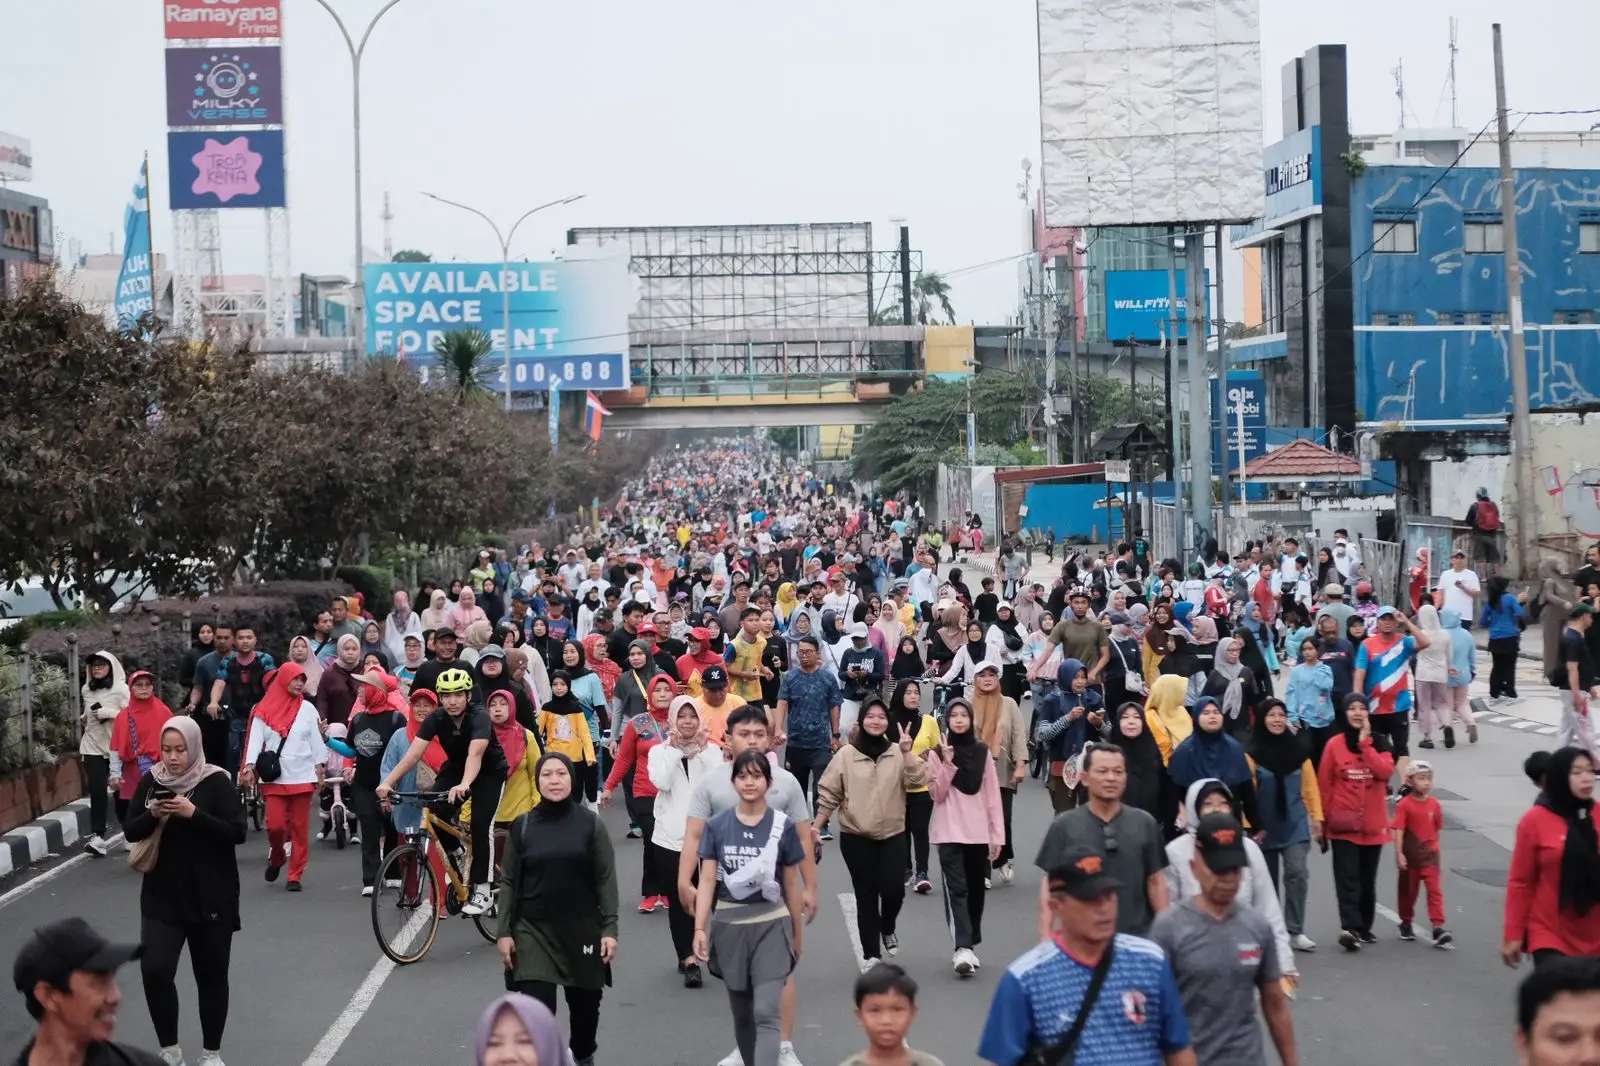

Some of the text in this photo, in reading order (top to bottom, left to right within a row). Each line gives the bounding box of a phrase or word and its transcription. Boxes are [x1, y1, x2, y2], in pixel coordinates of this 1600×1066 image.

[166, 4, 278, 26] Ramayana
[239, 22, 278, 34] Prime
[192, 97, 260, 109] MILKY
[186, 108, 268, 119] VERSE
[375, 270, 559, 294] AVAILABLE
[375, 300, 482, 324] SPACE
[1114, 299, 1143, 309] WILL
[490, 328, 560, 351] ENT
[563, 360, 611, 382] 888
[723, 845, 737, 854] WE
[738, 846, 758, 856] ARE
